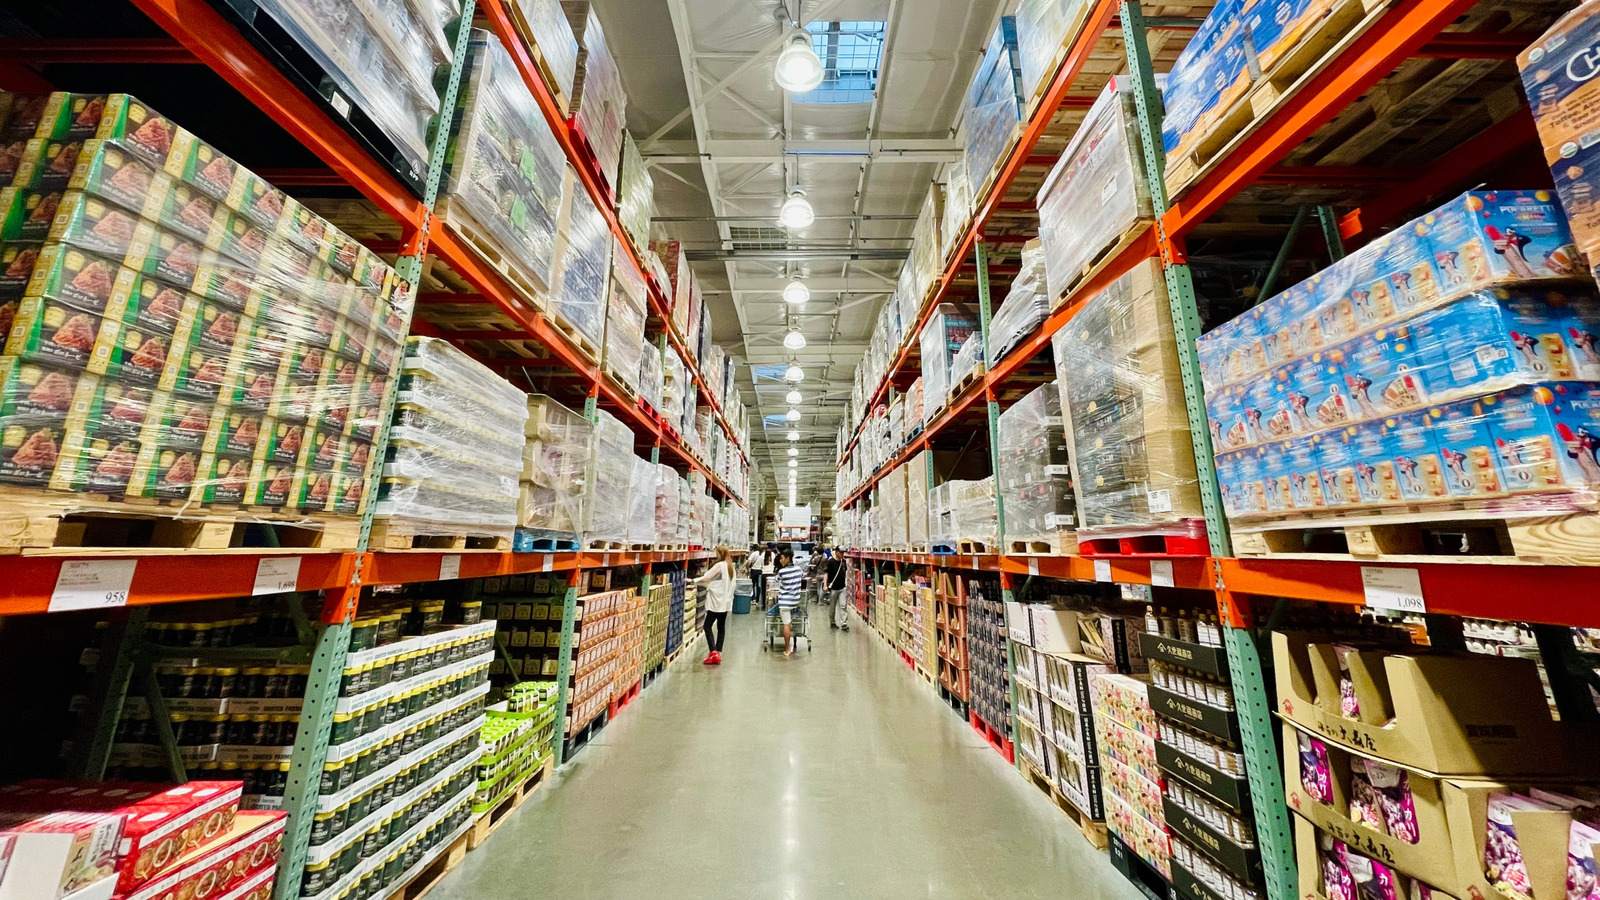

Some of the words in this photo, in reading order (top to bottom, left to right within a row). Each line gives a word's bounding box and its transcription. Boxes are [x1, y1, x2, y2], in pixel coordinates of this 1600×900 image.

[277, 580, 296, 591] 1,698
[105, 591, 126, 604] 958
[1397, 597, 1423, 608] 1,098
